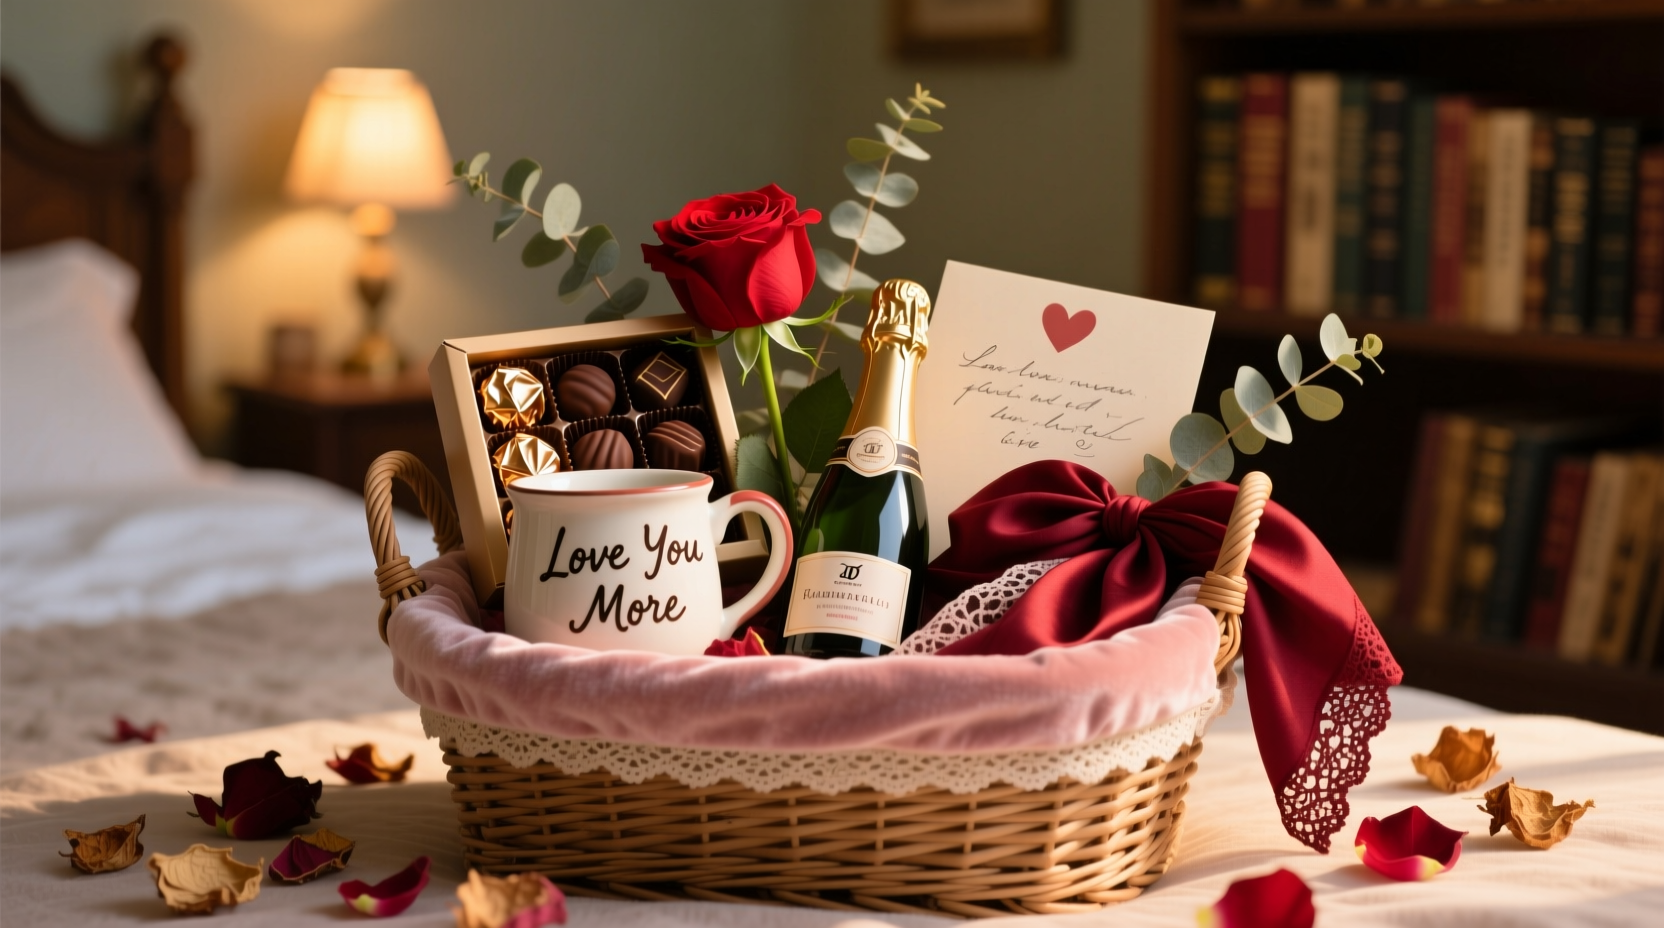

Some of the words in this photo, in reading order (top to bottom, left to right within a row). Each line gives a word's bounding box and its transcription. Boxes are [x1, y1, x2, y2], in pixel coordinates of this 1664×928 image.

[540, 526, 630, 582] Love
[643, 523, 703, 580] You
[569, 584, 686, 634] More
